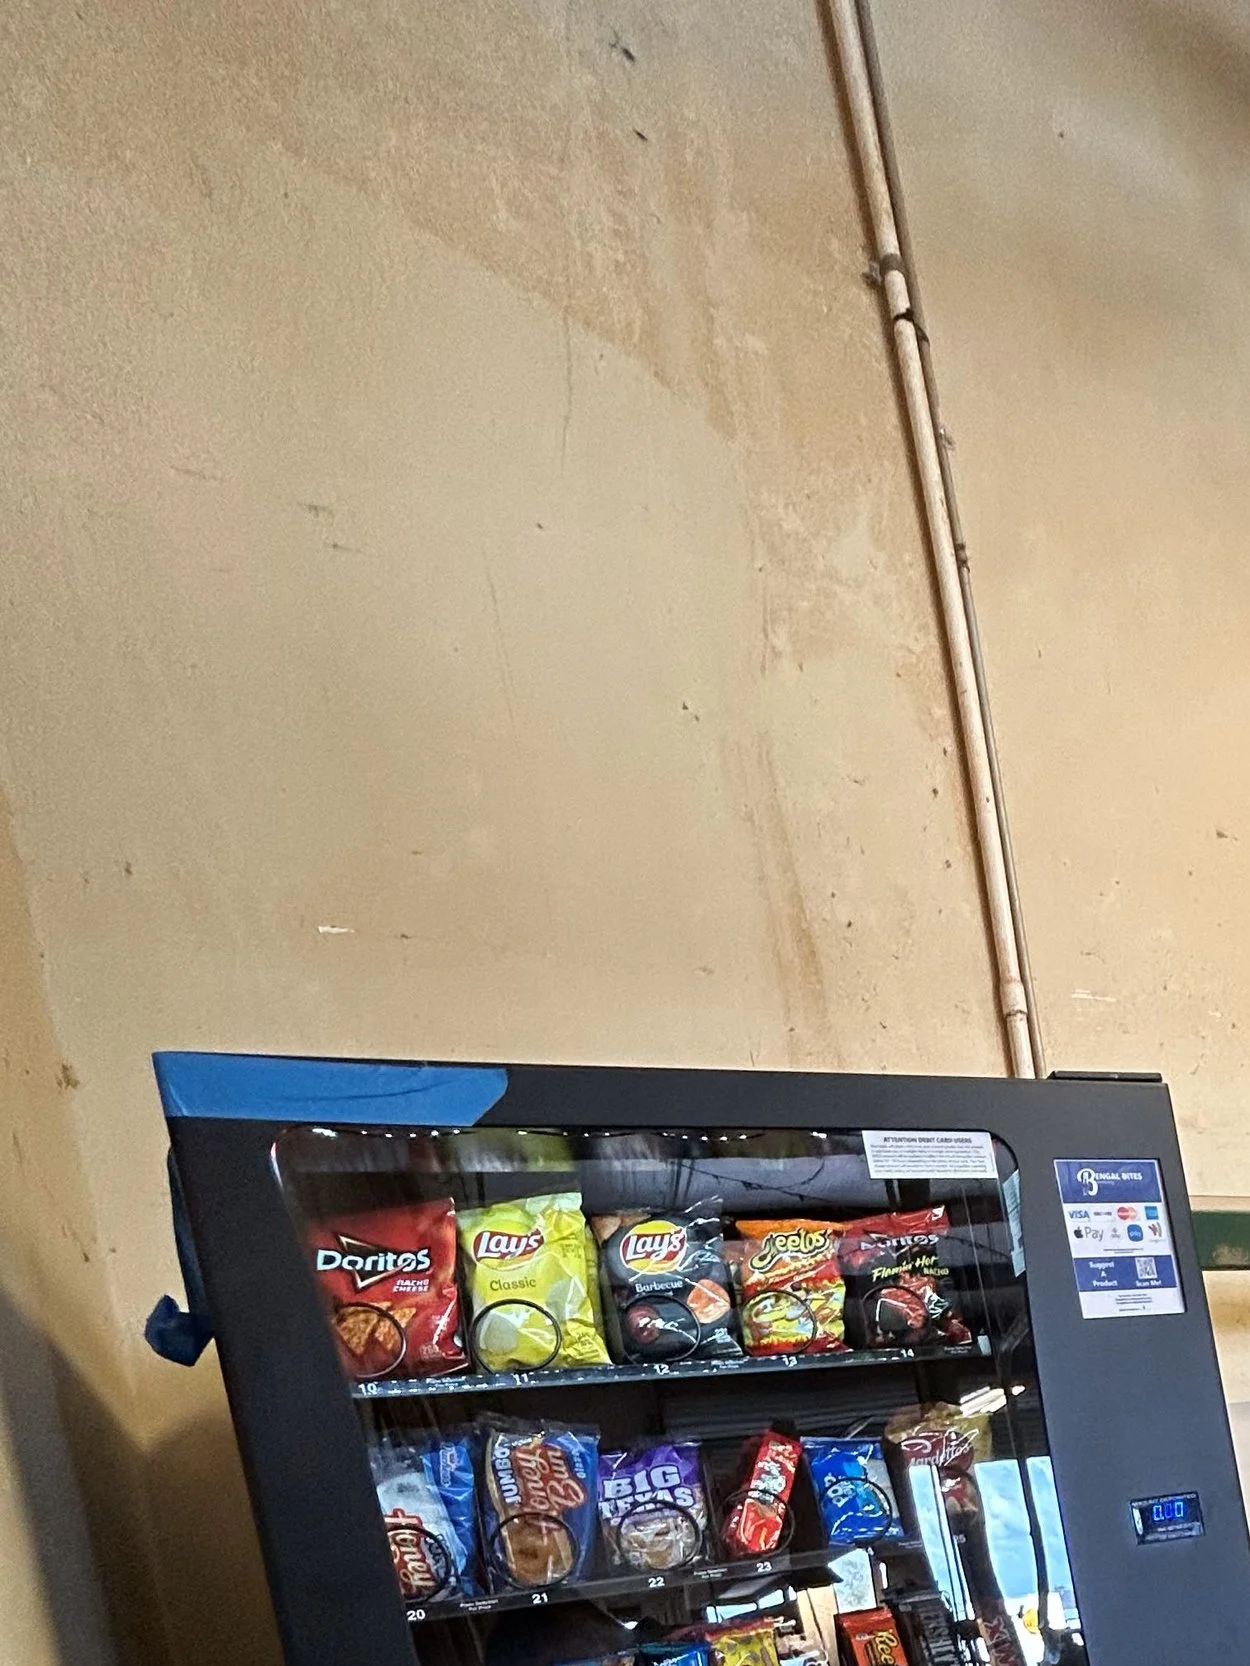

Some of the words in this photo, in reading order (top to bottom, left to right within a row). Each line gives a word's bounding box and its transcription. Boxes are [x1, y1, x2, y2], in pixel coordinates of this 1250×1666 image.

[1121, 1172, 1143, 1180] BITES
[1069, 1210, 1090, 1219] VISA
[1084, 1226, 1104, 1243] Pay
[477, 1230, 544, 1260] Lay's
[626, 1227, 685, 1263] Lay's
[316, 1248, 431, 1272] Doritos
[914, 1255, 939, 1269] Hot
[923, 1267, 950, 1276] NACHO
[393, 1284, 429, 1293] CHEESE
[396, 1278, 429, 1286] NACHO
[489, 1276, 537, 1292] Classic
[635, 1280, 683, 1293] Barbecue
[1092, 1279, 1118, 1287] Product
[901, 1349, 915, 1359] 14
[782, 1355, 798, 1368] 13
[654, 1364, 671, 1375] 12
[513, 1373, 529, 1386] 11
[495, 1443, 522, 1505] JUMBO
[603, 1465, 681, 1499] BIG
[598, 1487, 694, 1519] TEXAS
[1152, 1501, 1184, 1521] 0.00
[756, 1562, 772, 1573] 23
[648, 1577, 665, 1588] 22
[531, 1593, 549, 1605] 21
[406, 1609, 426, 1621] 20
